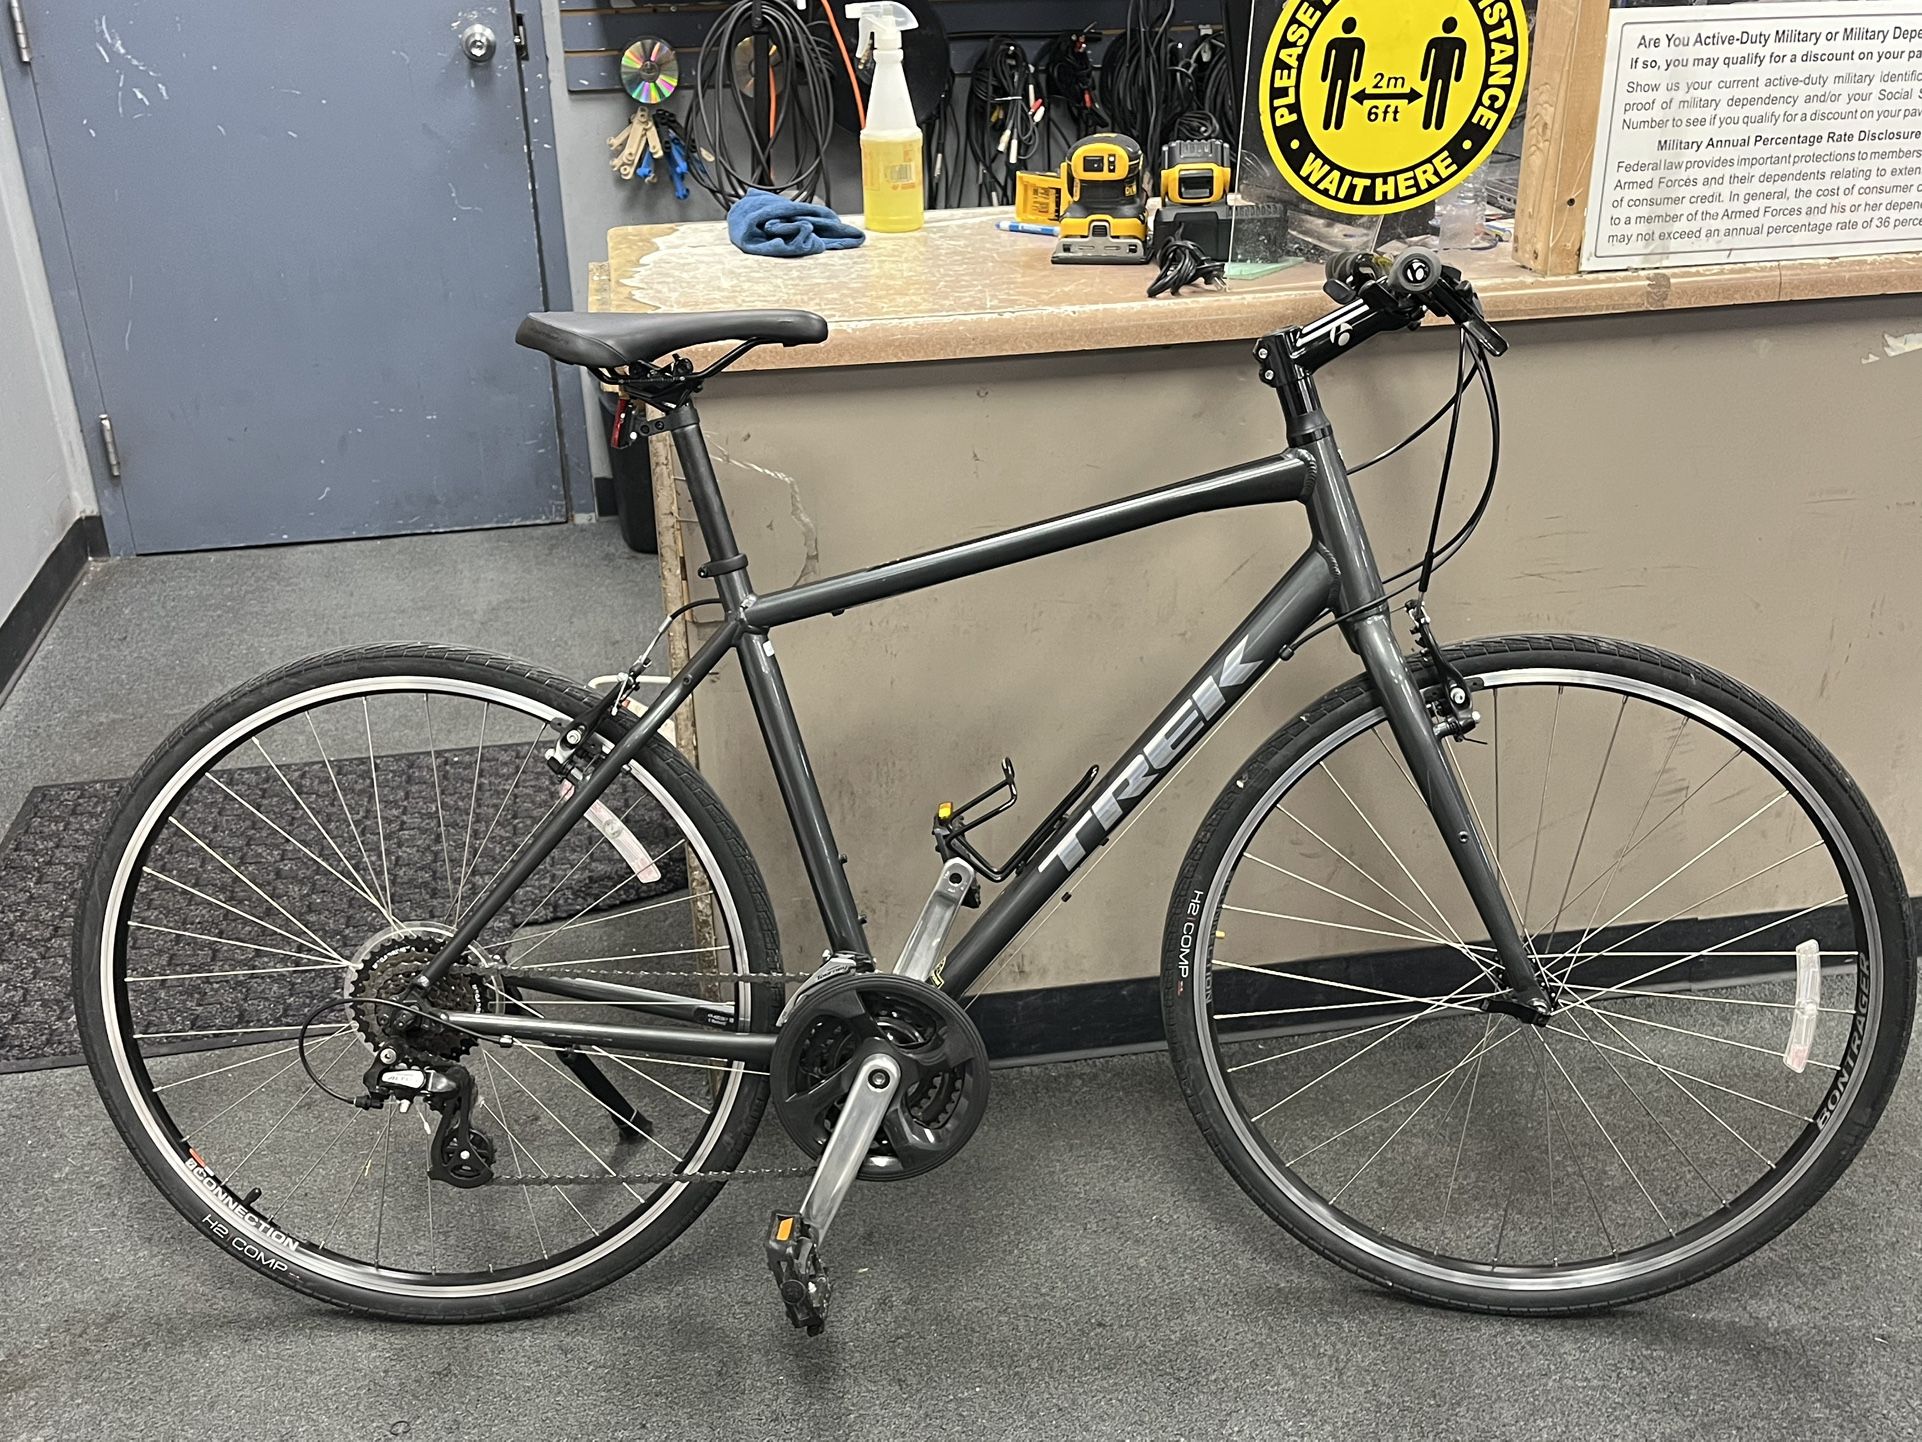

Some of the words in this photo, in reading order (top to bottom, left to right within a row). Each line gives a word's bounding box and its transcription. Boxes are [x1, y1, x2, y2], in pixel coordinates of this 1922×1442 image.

[1636, 35, 1660, 48] Are
[1665, 34, 1690, 48] You
[1692, 31, 1771, 47] Active-Duty
[1773, 30, 1822, 45] Military
[1824, 31, 1840, 42] or
[1842, 27, 1889, 43] Military
[1273, 2, 1322, 127] PLEASE
[1629, 56, 1639, 69] If
[1641, 59, 1660, 70] so,
[1664, 57, 1688, 71] you
[1692, 56, 1719, 69] may
[1722, 52, 1766, 68] qualify
[1768, 51, 1787, 64] for
[1789, 53, 1796, 63] a
[1800, 49, 1854, 62] discount
[1857, 51, 1873, 60] on
[1876, 49, 1905, 63] your
[1372, 72, 1406, 90] 2m
[1625, 80, 1661, 93] Show
[1665, 81, 1680, 91] us
[1685, 80, 1712, 94] your
[1717, 76, 1759, 89] current
[1764, 73, 1828, 88] active-duty
[1833, 72, 1875, 86] military
[1367, 104, 1400, 123] 6ft
[1623, 98, 1656, 114] proof
[1660, 97, 1674, 110] of
[1678, 96, 1721, 111] military
[1726, 93, 1799, 109] dependency
[1803, 90, 1842, 104] and/or
[1846, 91, 1872, 104] your
[1877, 87, 1913, 100] Social
[1621, 116, 1669, 130] Number
[1671, 116, 1683, 127] to
[1684, 117, 1706, 127] see
[1708, 113, 1717, 126] if
[1717, 115, 1739, 128] you
[1742, 110, 1780, 126] qualify
[1782, 110, 1798, 122] for
[1799, 112, 1807, 122] a
[1809, 108, 1858, 121] discount
[1859, 109, 1874, 119] on
[1875, 108, 1902, 121] your
[1656, 138, 1703, 152] Military
[1704, 135, 1750, 149] Annual
[1753, 133, 1823, 146] Percentage
[1826, 131, 1854, 143] Rate
[1857, 128, 1921, 141] Disclosure
[1616, 158, 1662, 172] Federal
[1663, 158, 1684, 170] law
[1684, 155, 1734, 172] provides
[1736, 153, 1791, 168] important
[1791, 150, 1855, 166] protections
[1857, 150, 1868, 160] to
[1869, 147, 1922, 160] members
[1299, 152, 1372, 202] WAIT
[1375, 150, 1458, 201] HERE
[1613, 177, 1653, 190] Armed
[1657, 176, 1698, 188] Forces
[1702, 173, 1724, 186] and
[1728, 172, 1755, 184] their
[1758, 169, 1826, 184] dependents
[1829, 166, 1872, 180] relating
[1875, 166, 1886, 177] to
[1890, 165, 1921, 176] exten
[1611, 196, 1624, 208] of
[1626, 195, 1686, 207] consumer
[1688, 191, 1723, 204] credit.
[1728, 190, 1739, 202] In
[1742, 187, 1789, 204] general,
[1794, 187, 1812, 198] the
[1815, 185, 1840, 197] cost
[1842, 183, 1856, 196] of
[1857, 183, 1914, 195] consumer
[1609, 215, 1621, 226] to
[1623, 216, 1631, 225] a
[1634, 211, 1684, 224] member
[1686, 209, 1698, 222] of
[1700, 209, 1719, 221] the
[1720, 206, 1760, 220] Armed
[1762, 205, 1802, 217] Forces
[1804, 202, 1827, 216] and
[1829, 201, 1846, 214] his
[1849, 203, 1862, 212] or
[1863, 200, 1883, 212] her
[1607, 233, 1633, 246] may
[1635, 229, 1654, 242] not
[1658, 226, 1702, 240] exceed
[1704, 228, 1720, 239] an
[1722, 223, 1764, 237] annual
[1766, 221, 1832, 237] percentage
[1835, 219, 1858, 230] rate
[1861, 216, 1874, 229] of
[1875, 216, 1890, 228] 36
[1037, 633, 1265, 873] TREK
[1187, 889, 1204, 916] H2
[1178, 922, 1195, 978] COMP
[1816, 951, 1870, 1131] BONTRAGER
[193, 1167, 300, 1251] CONNECTION
[202, 1213, 229, 1239] H2
[231, 1237, 288, 1272] COMP
